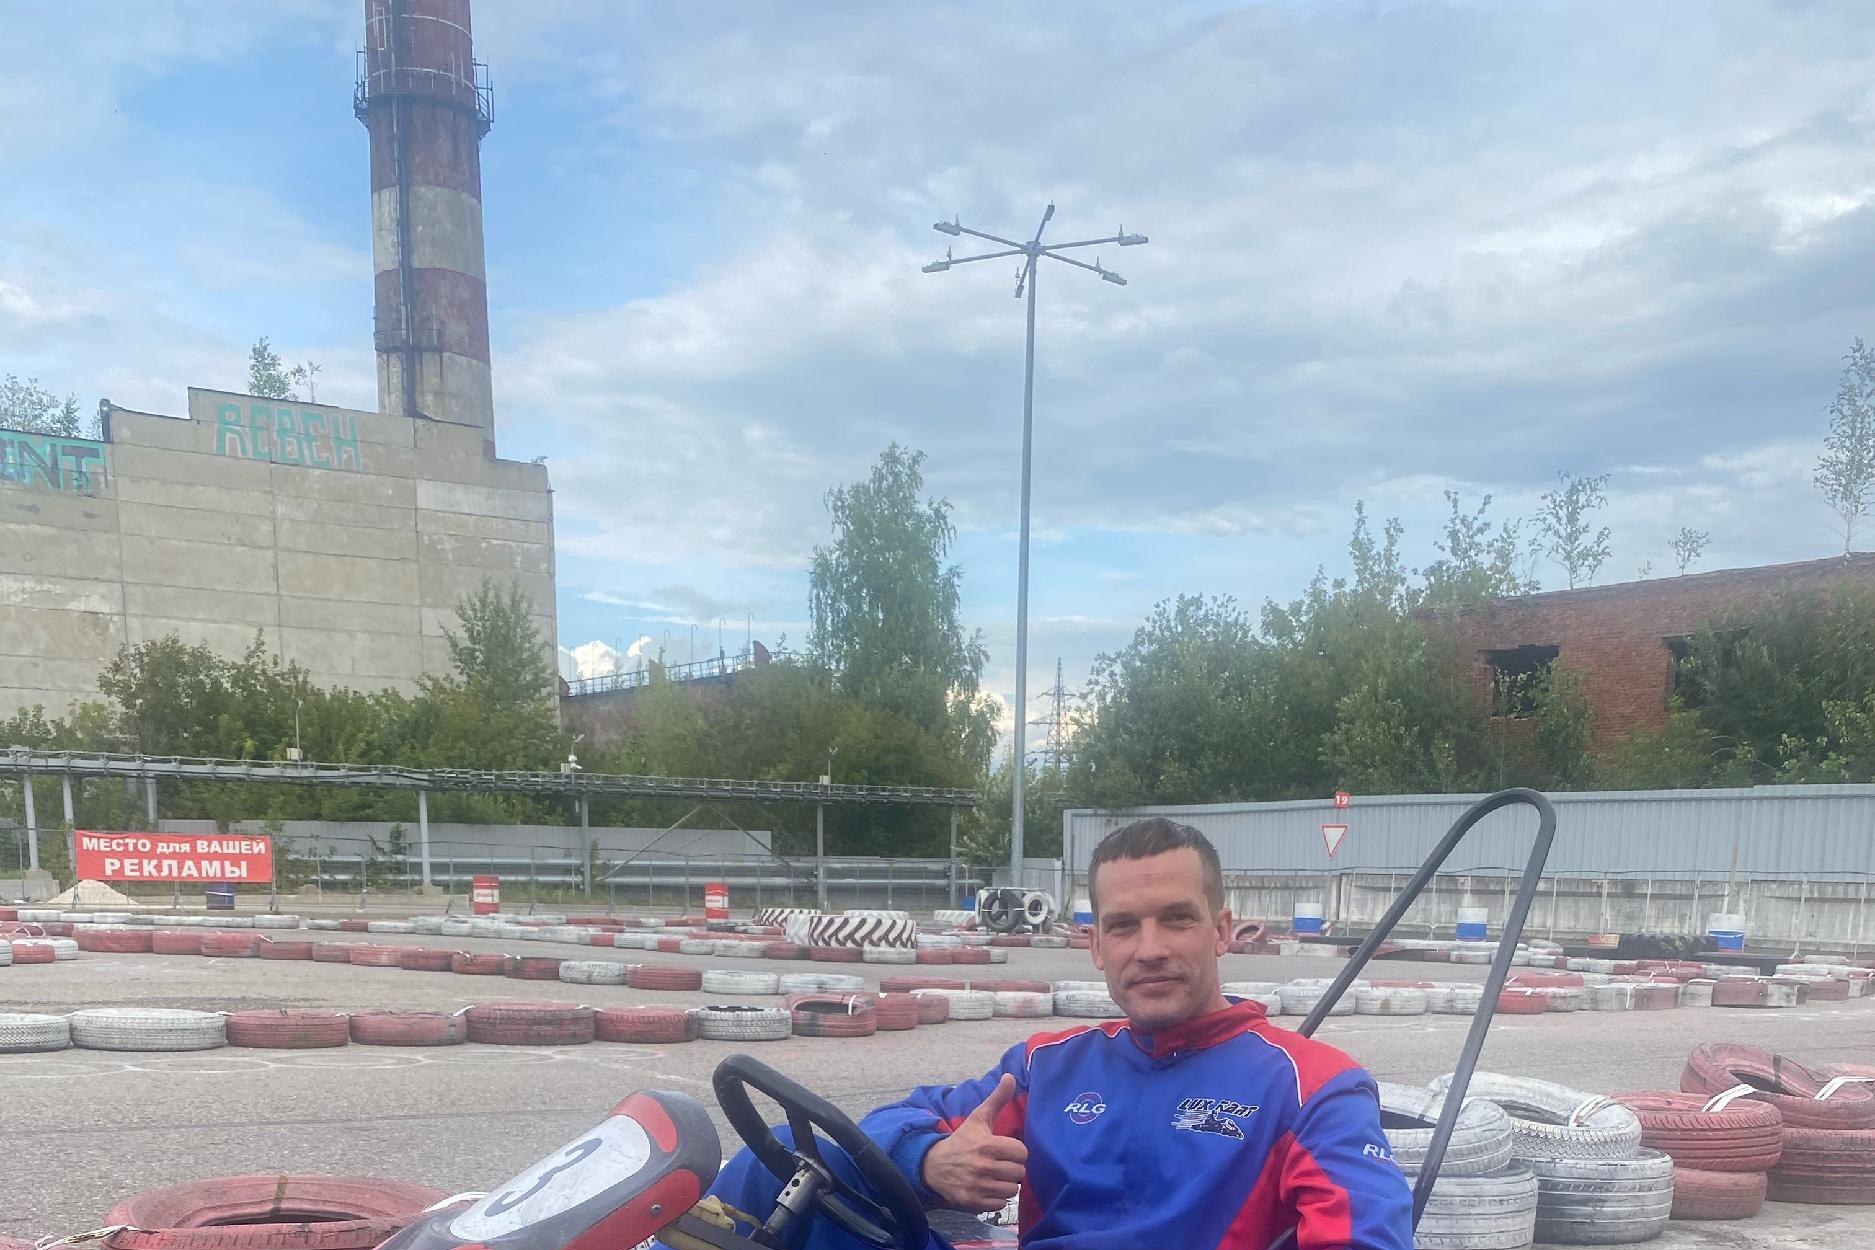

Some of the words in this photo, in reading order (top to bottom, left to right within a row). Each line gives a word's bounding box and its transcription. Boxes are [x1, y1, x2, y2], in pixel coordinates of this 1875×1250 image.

[1335, 795, 1348, 805] 19
[82, 836, 150, 852] МЕСТО
[157, 842, 190, 854] для
[196, 840, 265, 855] ВАШЕЙ
[104, 858, 248, 878] РЕКЛАМЫ
[1064, 1103, 1107, 1114] RLG
[484, 1137, 602, 1217] 3
